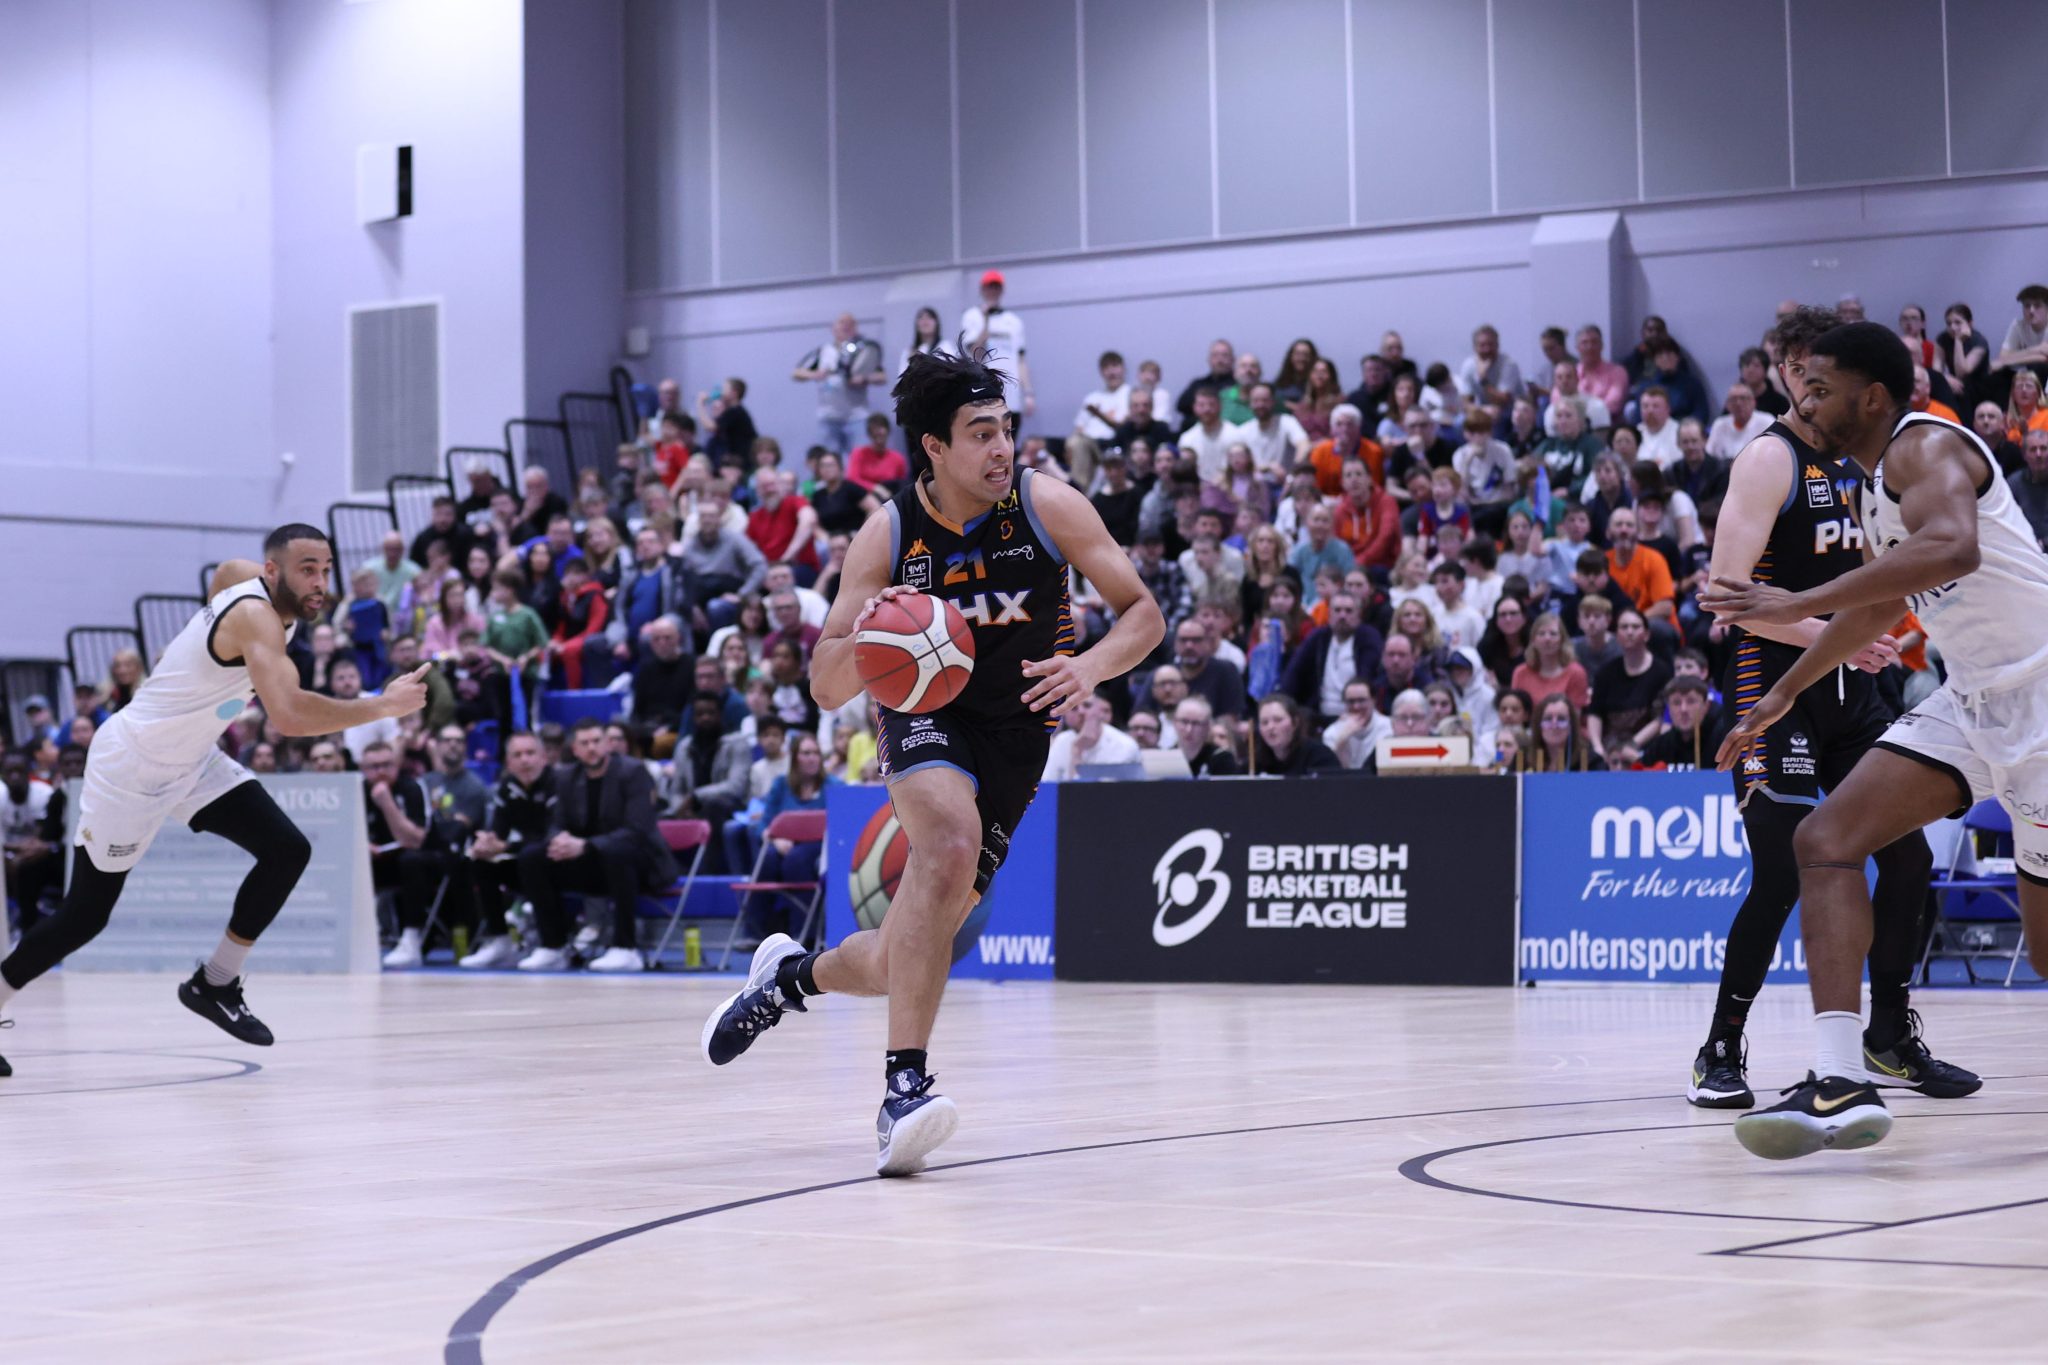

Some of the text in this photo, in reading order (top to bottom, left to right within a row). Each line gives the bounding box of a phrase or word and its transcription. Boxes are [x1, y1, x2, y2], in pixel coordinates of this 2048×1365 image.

[1814, 517, 1864, 554] PH
[943, 547, 987, 586] 21
[947, 588, 1032, 627] HX
[266, 787, 341, 811] ATORS
[1590, 794, 1752, 860] molt
[1248, 844, 1409, 871] BRITISH
[1247, 874, 1407, 898] BASKETBALL
[1581, 869, 1629, 901] For
[1632, 867, 1679, 898] the
[1682, 866, 1748, 898] real
[1246, 901, 1408, 929] LEAGUE
[978, 935, 1056, 965] www.
